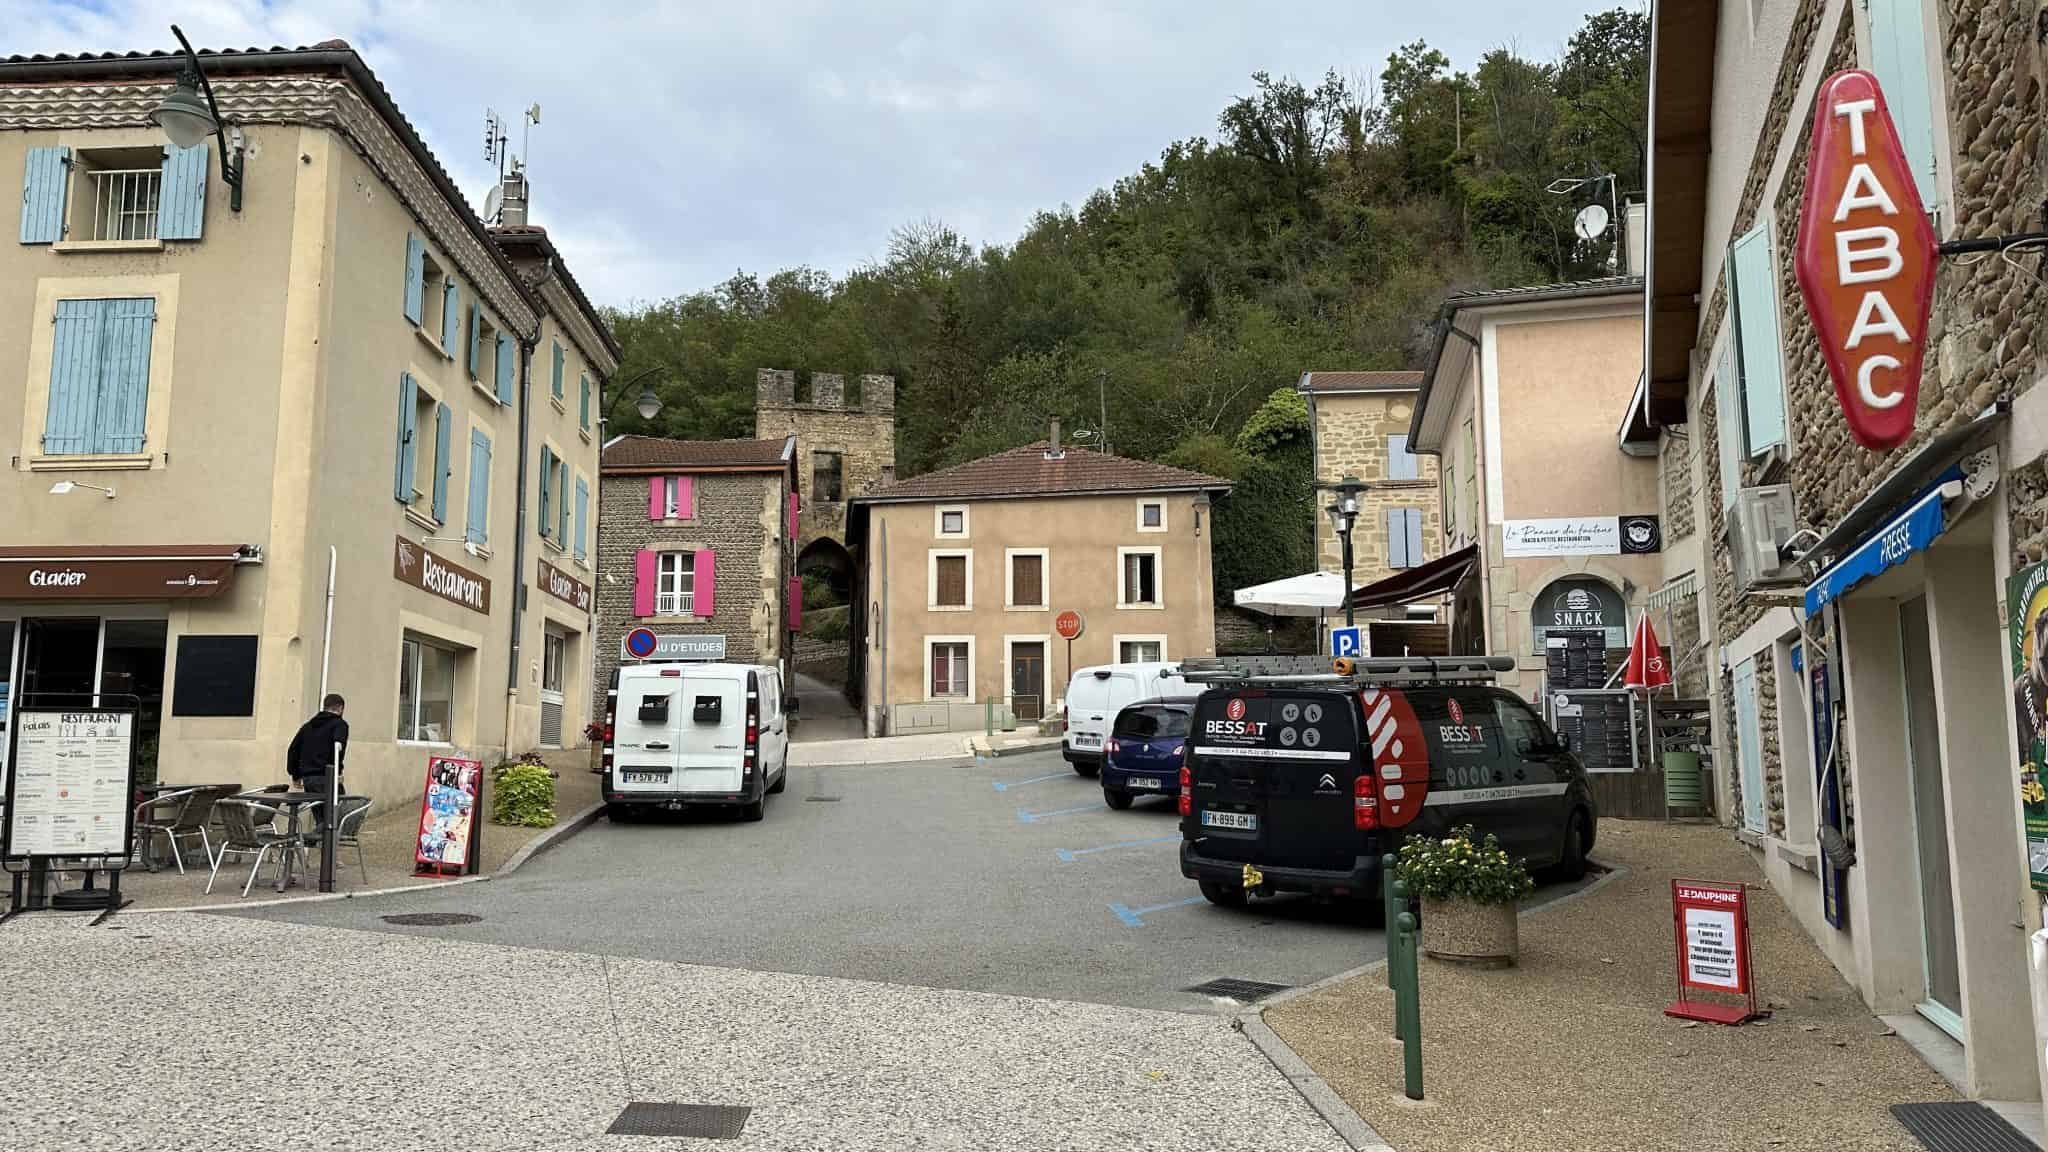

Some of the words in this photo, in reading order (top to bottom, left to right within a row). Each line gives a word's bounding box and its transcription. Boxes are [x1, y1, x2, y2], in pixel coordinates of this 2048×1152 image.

[1832, 99, 1910, 409] TABAC
[1880, 520, 1912, 565] PRESSE
[422, 551, 483, 609] Restaurant
[577, 583, 589, 609] Bar
[1058, 619, 1079, 630] STOP
[1554, 612, 1603, 626] SNACK
[671, 642, 723, 653] D'ETUDES
[1339, 634, 1353, 657] P
[61, 713, 121, 724] RESTAURANT
[1206, 720, 1267, 736] BESSAT
[1439, 725, 1483, 742] BESSAT
[1679, 889, 1690, 899] LE
